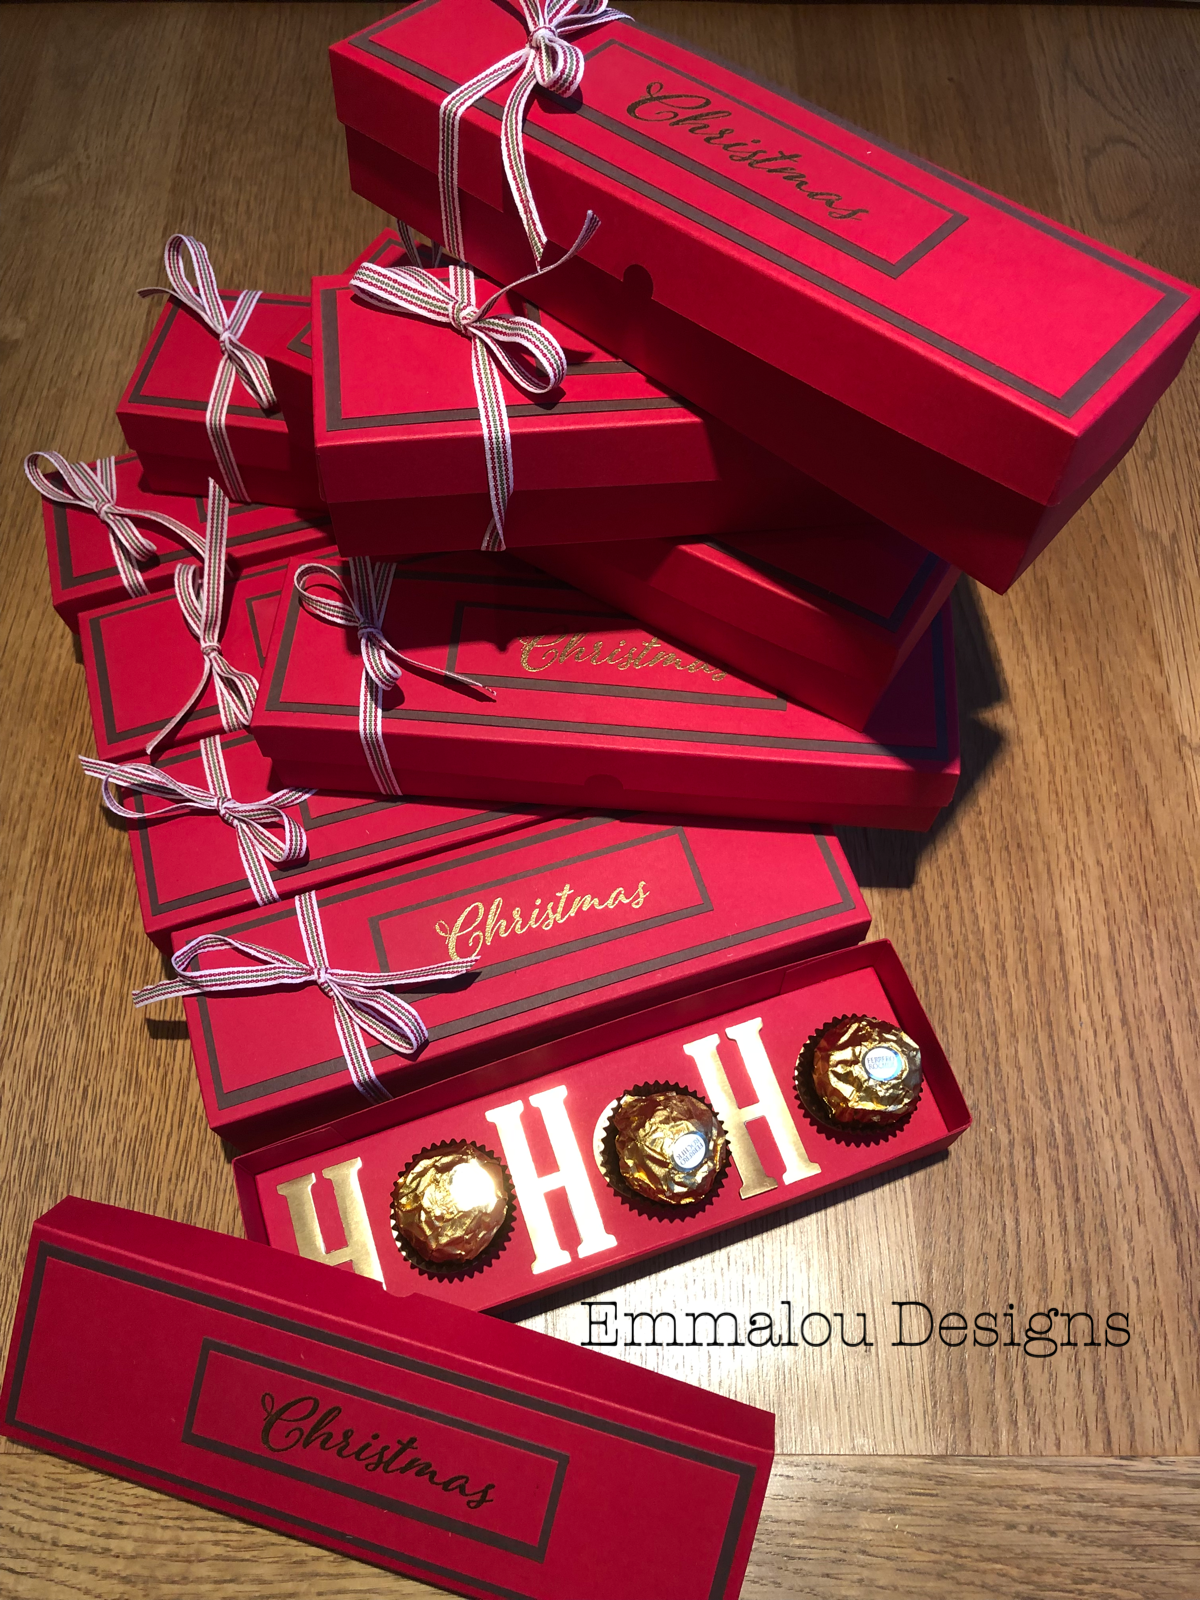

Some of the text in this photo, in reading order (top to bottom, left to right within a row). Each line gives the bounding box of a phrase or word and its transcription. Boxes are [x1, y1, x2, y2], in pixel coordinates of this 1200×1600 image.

[626, 81, 869, 221] Christmas
[434, 880, 650, 961] Christmas
[485, 1085, 618, 1275] H
[683, 1016, 822, 1200] H
[261, 1392, 496, 1510] Christmas
